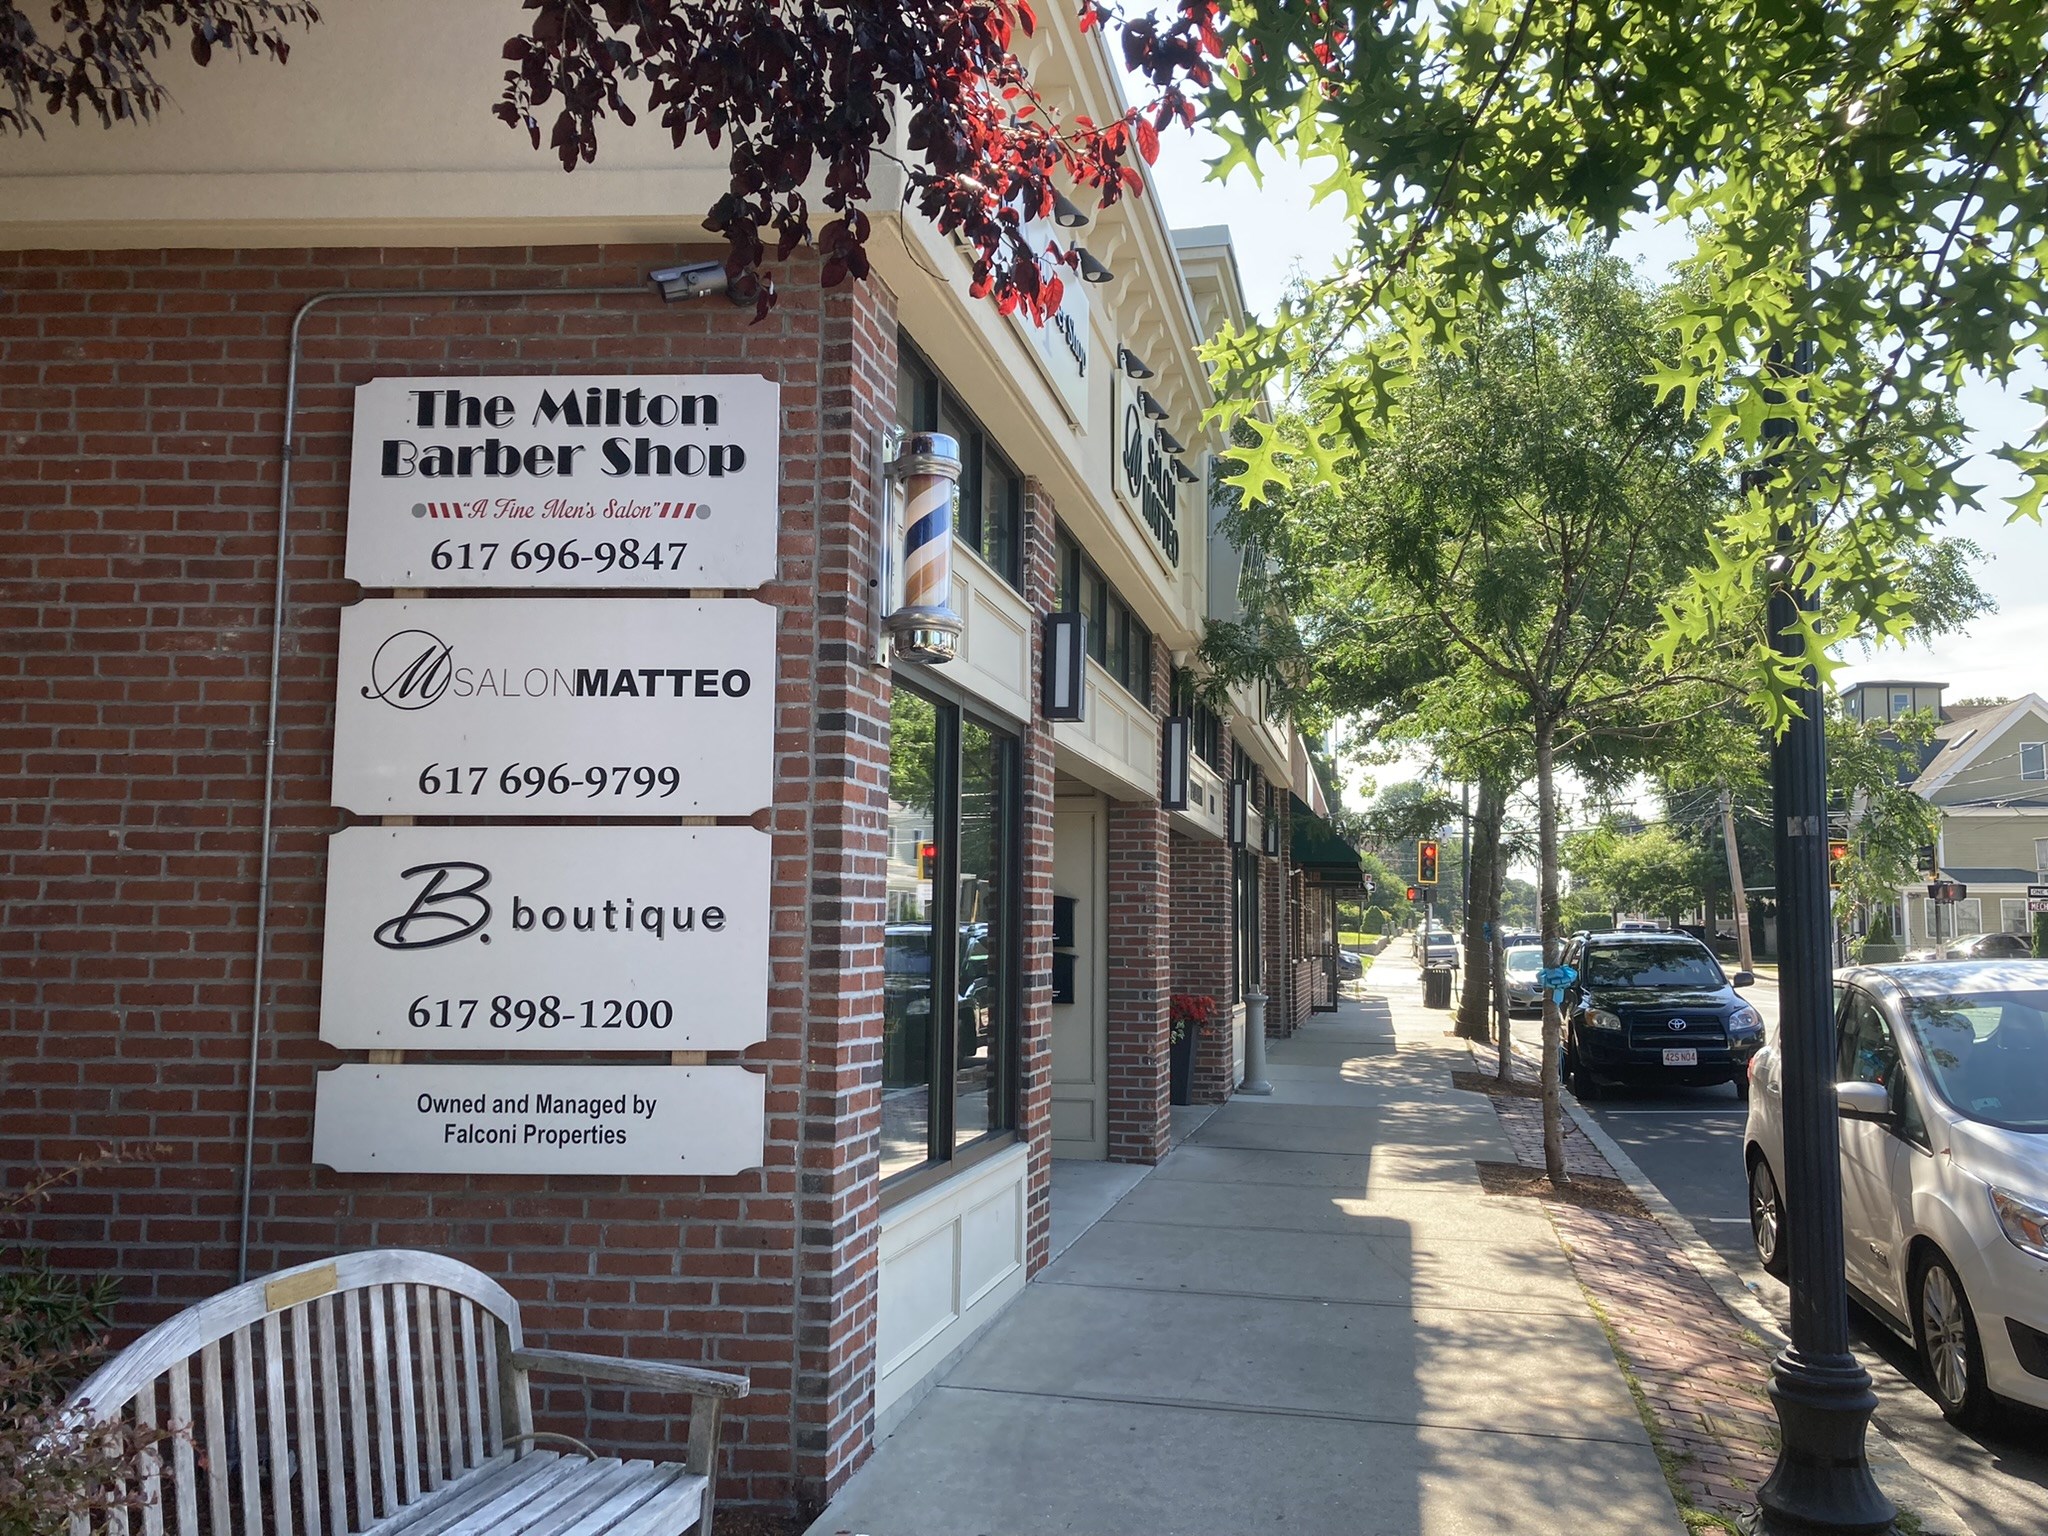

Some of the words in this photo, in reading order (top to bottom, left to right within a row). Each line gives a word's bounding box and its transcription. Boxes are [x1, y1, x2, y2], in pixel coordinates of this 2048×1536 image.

[409, 389, 515, 428] The
[532, 387, 719, 427] Milton
[381, 438, 585, 478] Barber
[600, 437, 746, 478] Shop
[493, 498, 535, 518] Fine
[431, 539, 500, 571] 617
[510, 538, 688, 574] 696-9847
[418, 762, 489, 795] 617
[499, 762, 680, 799] 696-9799
[512, 896, 726, 940] boutique
[408, 995, 479, 1029] 617
[489, 995, 673, 1033] 898-1200
[417, 1093, 486, 1114] Owned
[492, 1093, 529, 1114] and
[536, 1093, 626, 1120] Managed
[633, 1094, 657, 1120] by
[444, 1123, 517, 1144] Falconi
[523, 1124, 627, 1150] Properties
